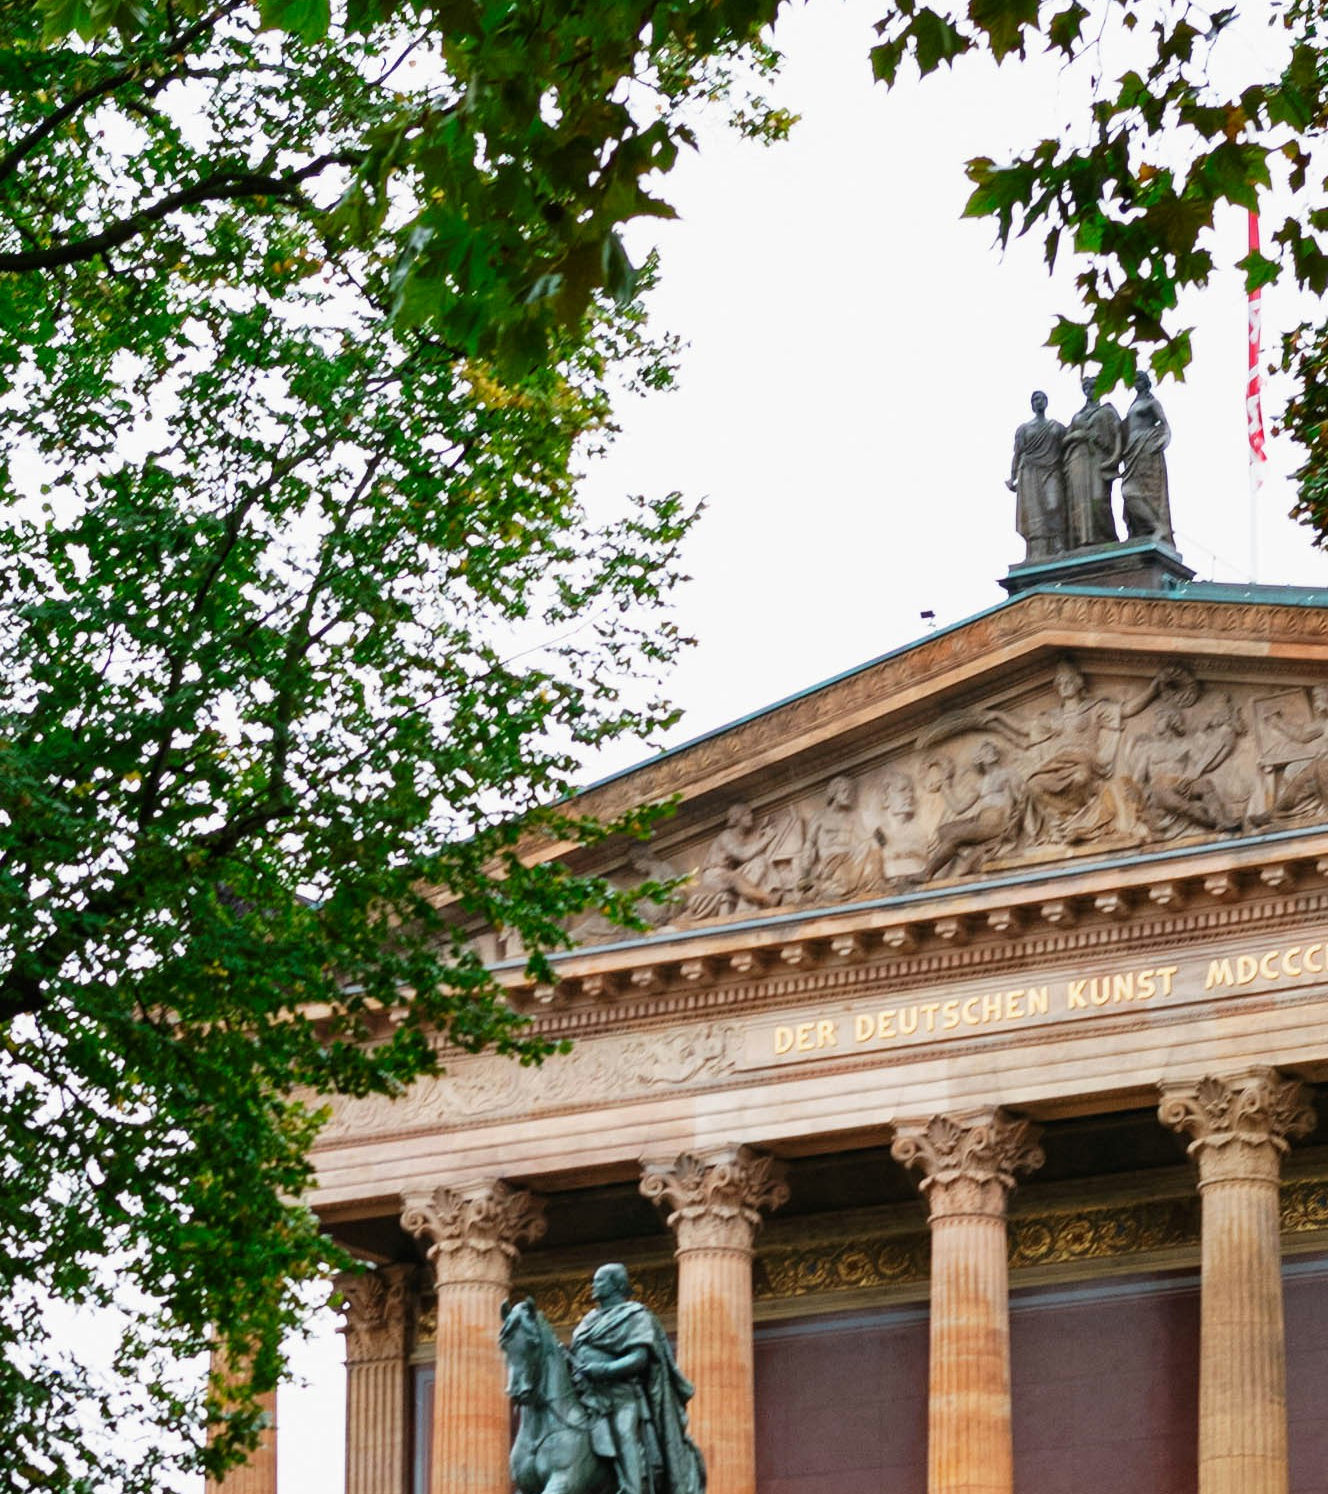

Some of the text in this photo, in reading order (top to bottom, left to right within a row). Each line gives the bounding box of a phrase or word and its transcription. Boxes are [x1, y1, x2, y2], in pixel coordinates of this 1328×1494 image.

[774, 1019, 837, 1054] DER
[855, 986, 1050, 1043] DEUTSCHEN
[1068, 965, 1178, 1009] KUNST
